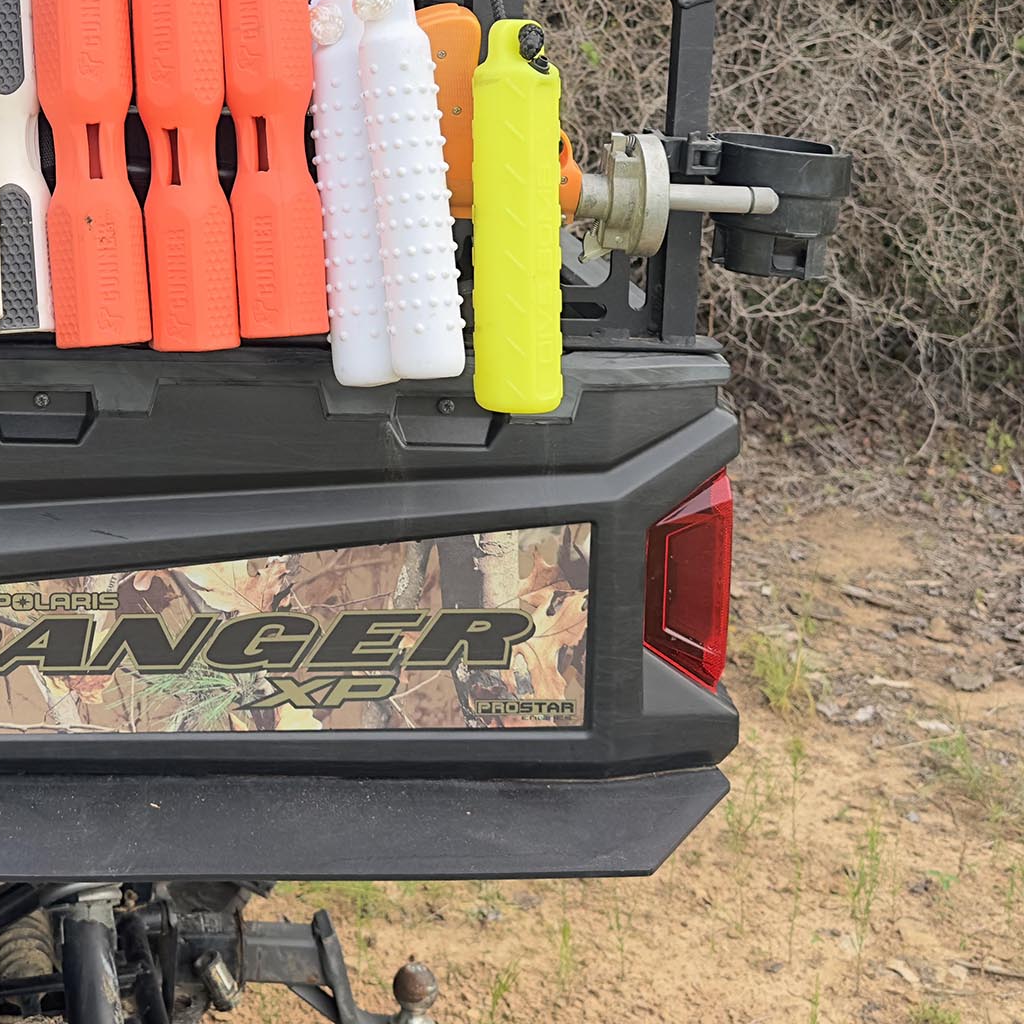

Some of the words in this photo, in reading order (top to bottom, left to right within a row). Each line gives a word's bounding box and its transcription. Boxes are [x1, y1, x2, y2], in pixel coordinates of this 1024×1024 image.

[254, 215, 274, 295] GUNNER
[233, 676, 399, 709] XP
[477, 701, 575, 714] PROSTAR
